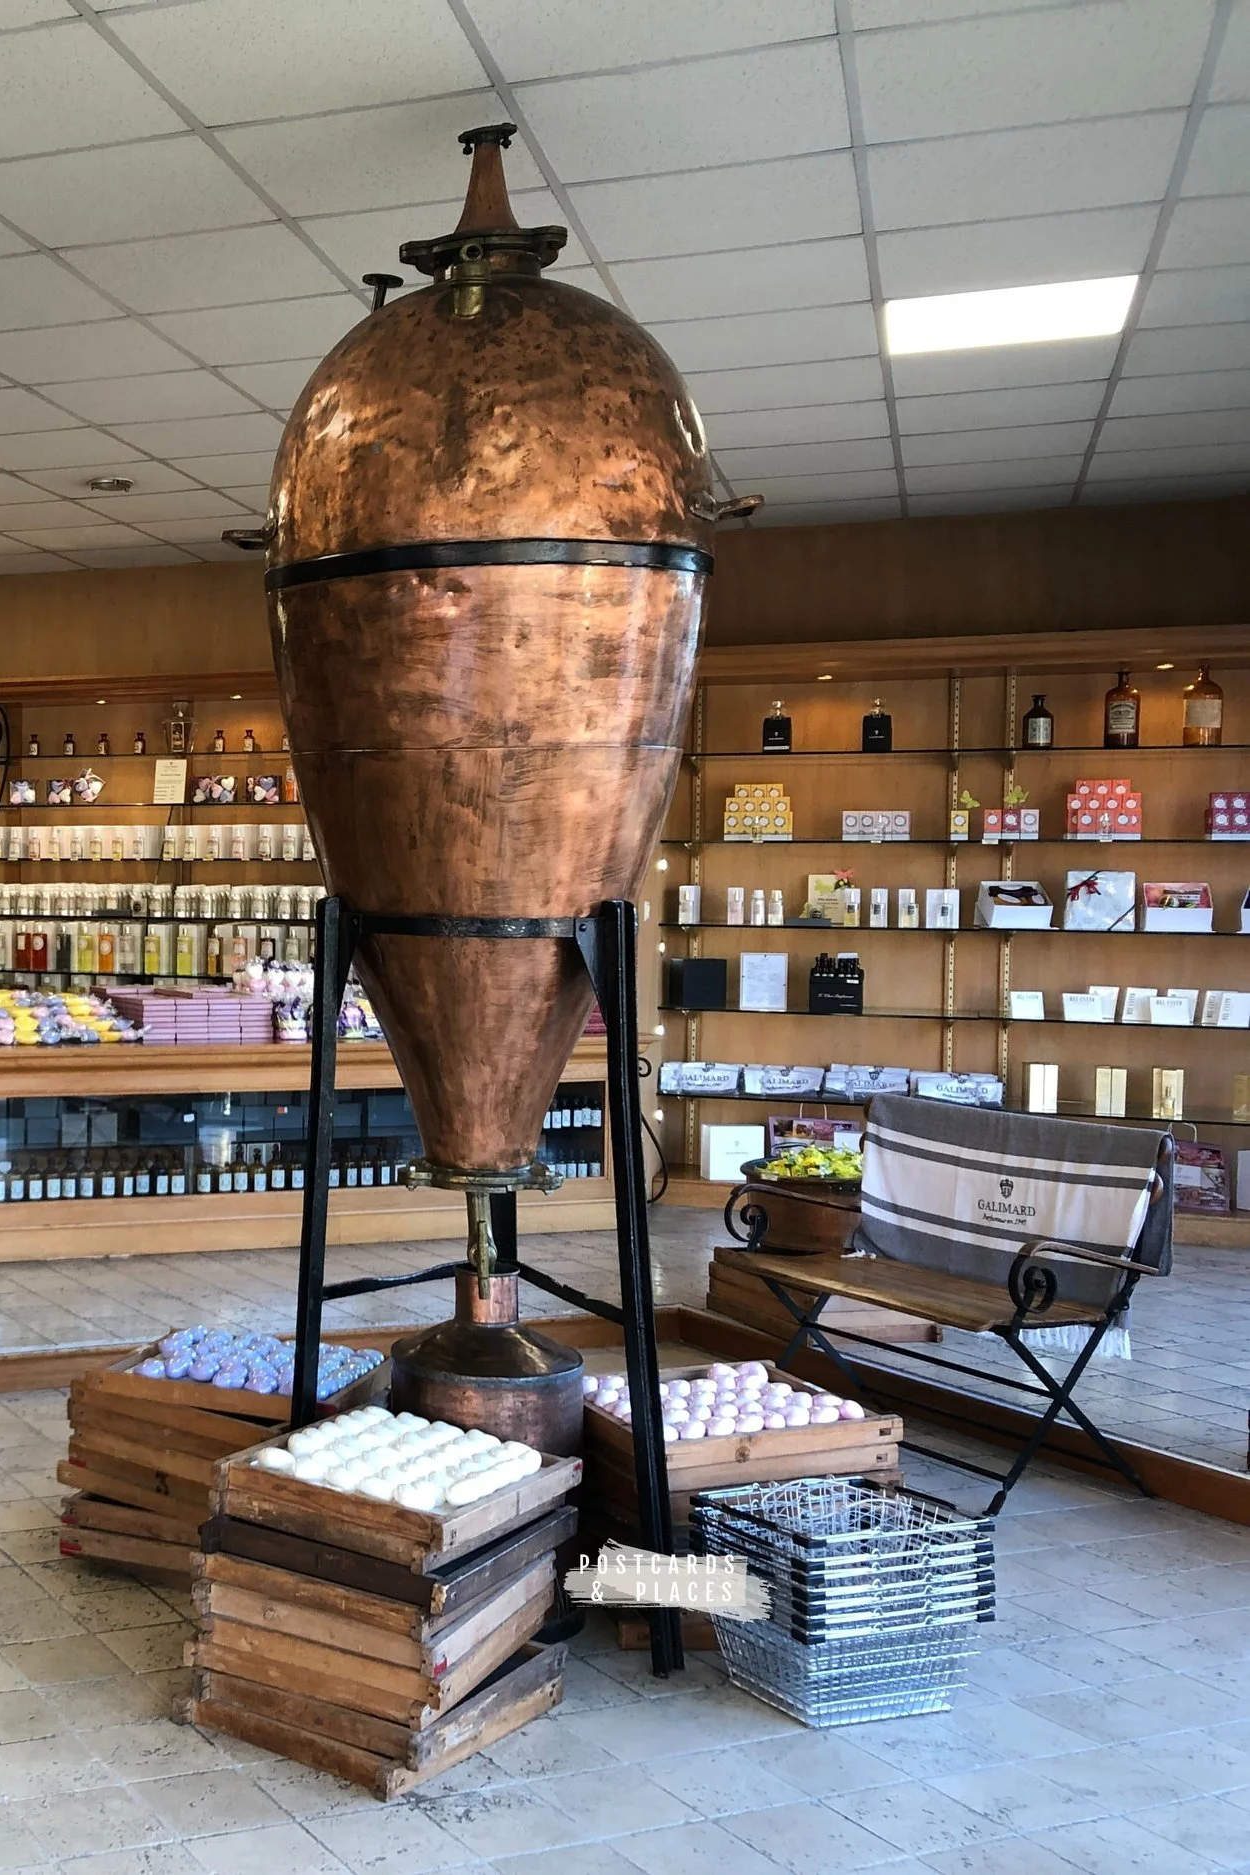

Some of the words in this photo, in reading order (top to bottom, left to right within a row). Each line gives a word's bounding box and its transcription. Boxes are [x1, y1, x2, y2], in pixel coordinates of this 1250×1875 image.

[681, 1074, 730, 1083] GALIMARD
[764, 1078, 809, 1086] ALIMARD
[936, 1084, 988, 1095] GALIMD
[977, 1199, 1036, 1217] GALIMARD
